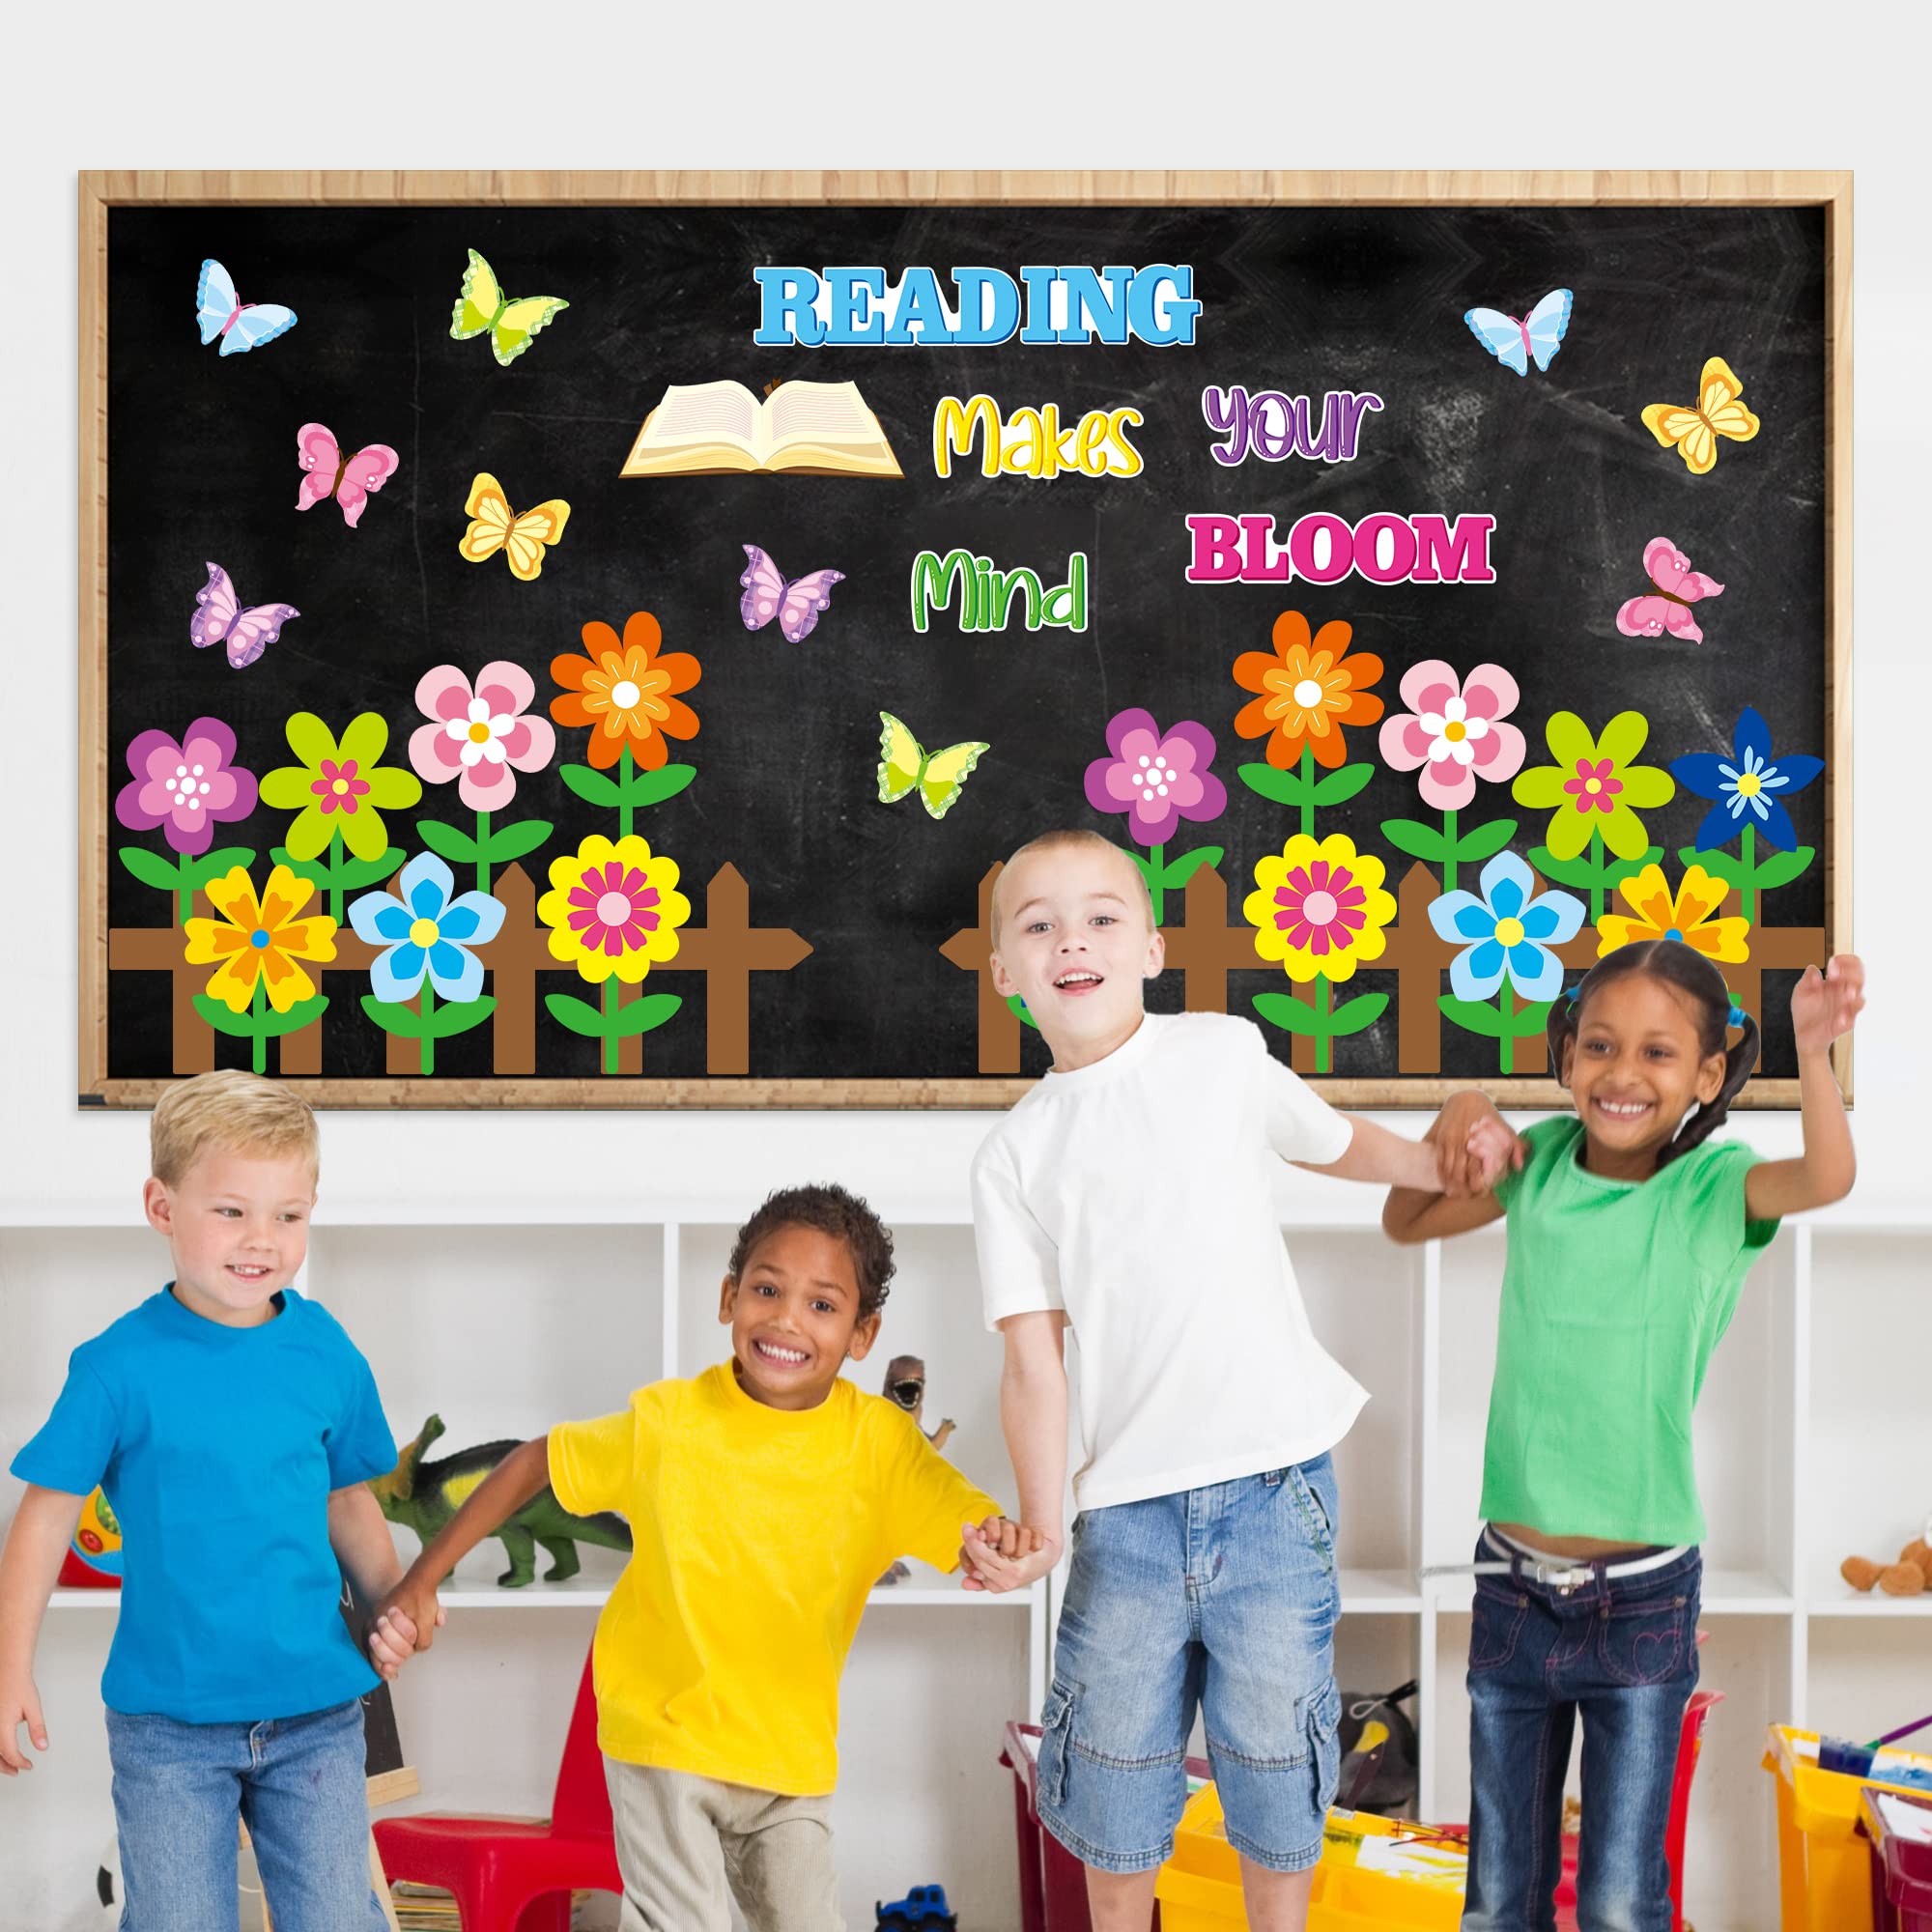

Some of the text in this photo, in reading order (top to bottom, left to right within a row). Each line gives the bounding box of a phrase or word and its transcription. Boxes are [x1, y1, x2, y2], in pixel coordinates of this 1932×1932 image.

[754, 265, 1202, 346] READING
[935, 387, 1382, 478] Makes your
[913, 514, 1495, 632] Mind BLOOM
